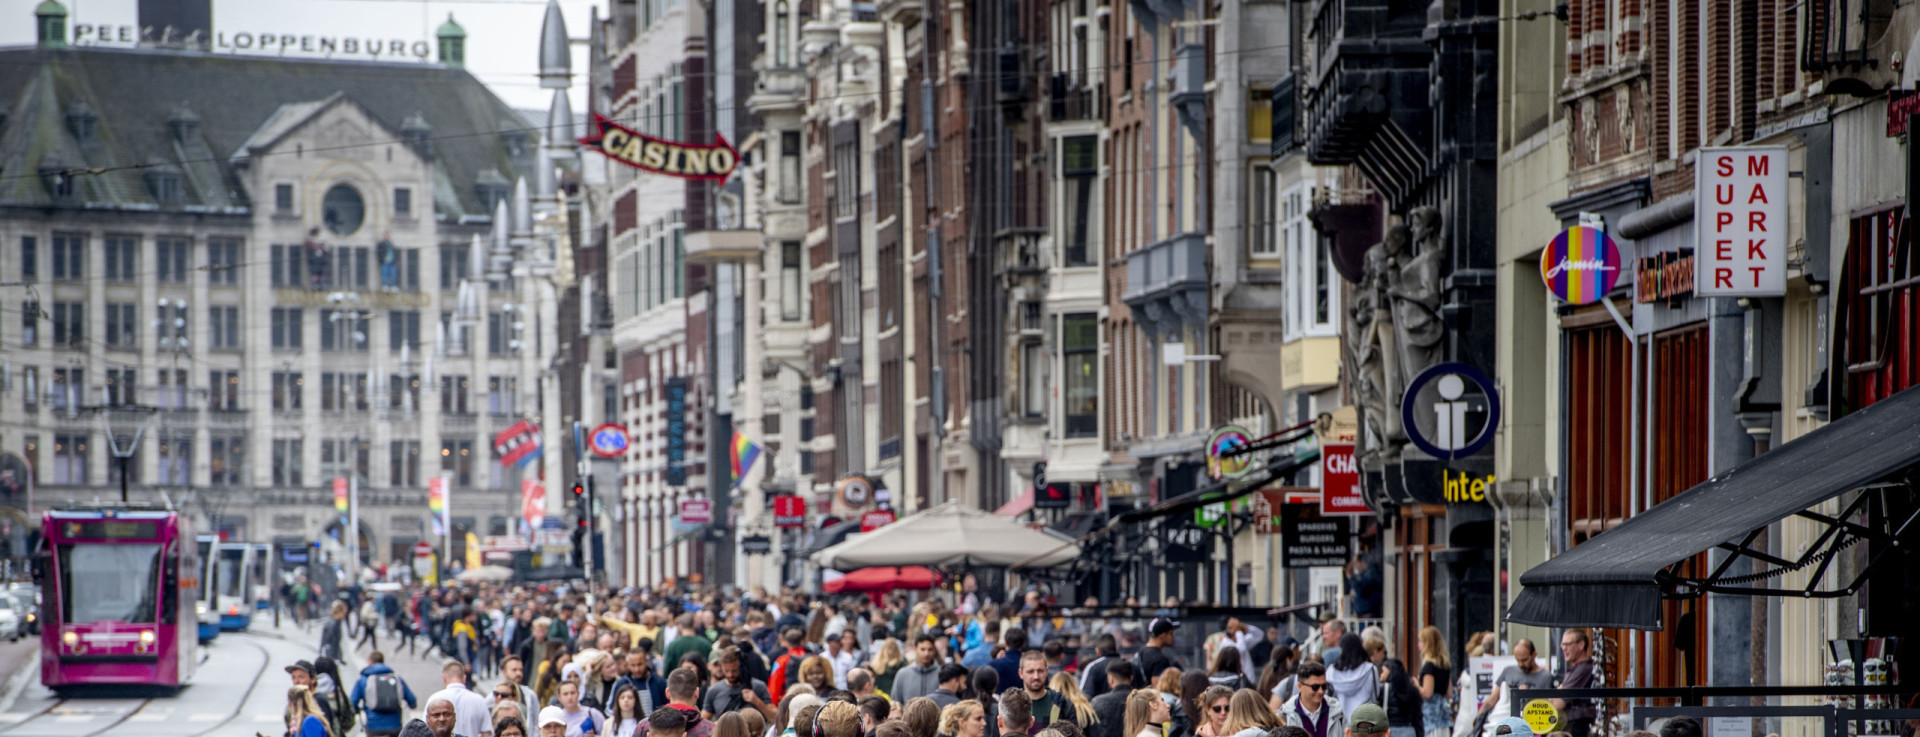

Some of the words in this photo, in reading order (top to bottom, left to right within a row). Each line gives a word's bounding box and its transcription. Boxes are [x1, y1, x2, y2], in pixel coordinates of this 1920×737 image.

[602, 128, 735, 175] CASINO
[1715, 156, 1734, 289] SUPER
[1748, 155, 1769, 288] MARKT
[1546, 256, 1616, 279] jamin
